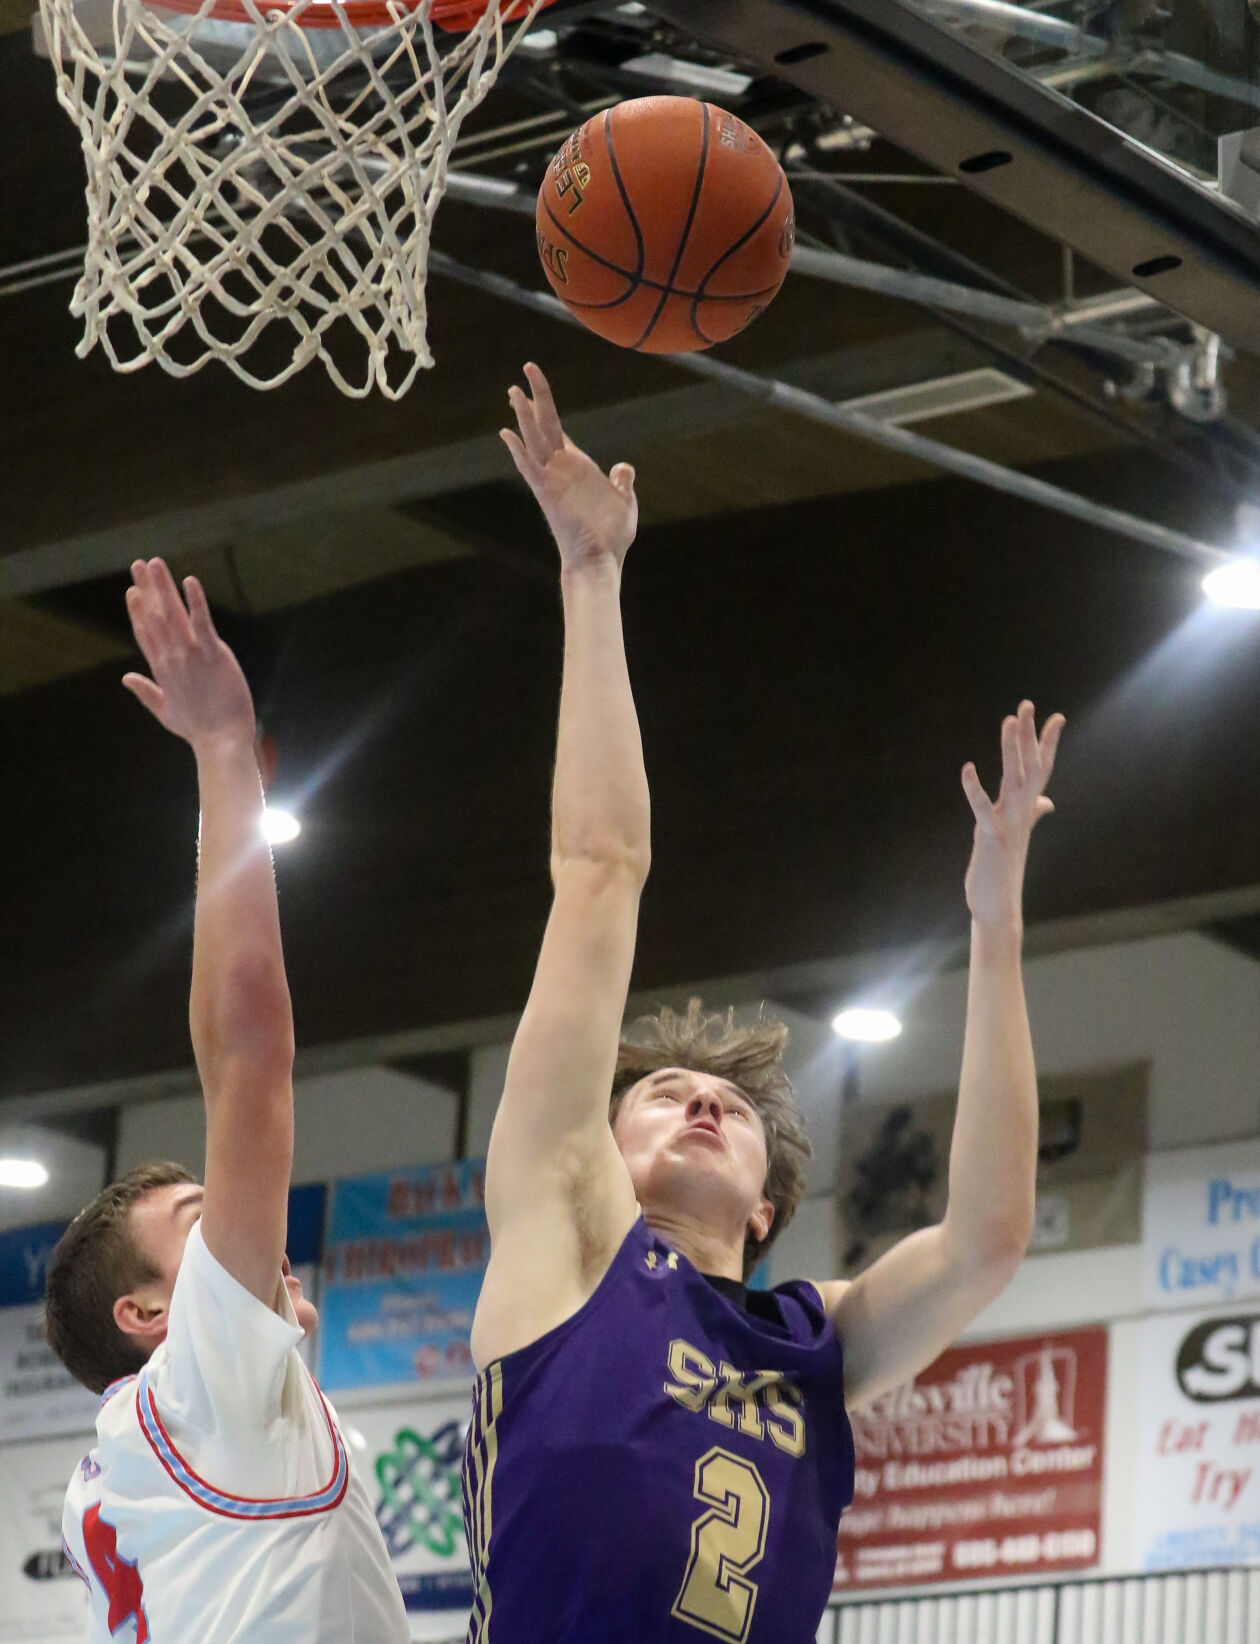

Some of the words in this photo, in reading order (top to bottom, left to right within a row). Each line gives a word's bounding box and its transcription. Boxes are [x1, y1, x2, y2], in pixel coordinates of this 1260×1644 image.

[882, 1455, 1008, 1491] Education
[1011, 1446, 1096, 1477] Center
[1190, 1460, 1252, 1512] Try
[671, 1445, 771, 1644] 2
